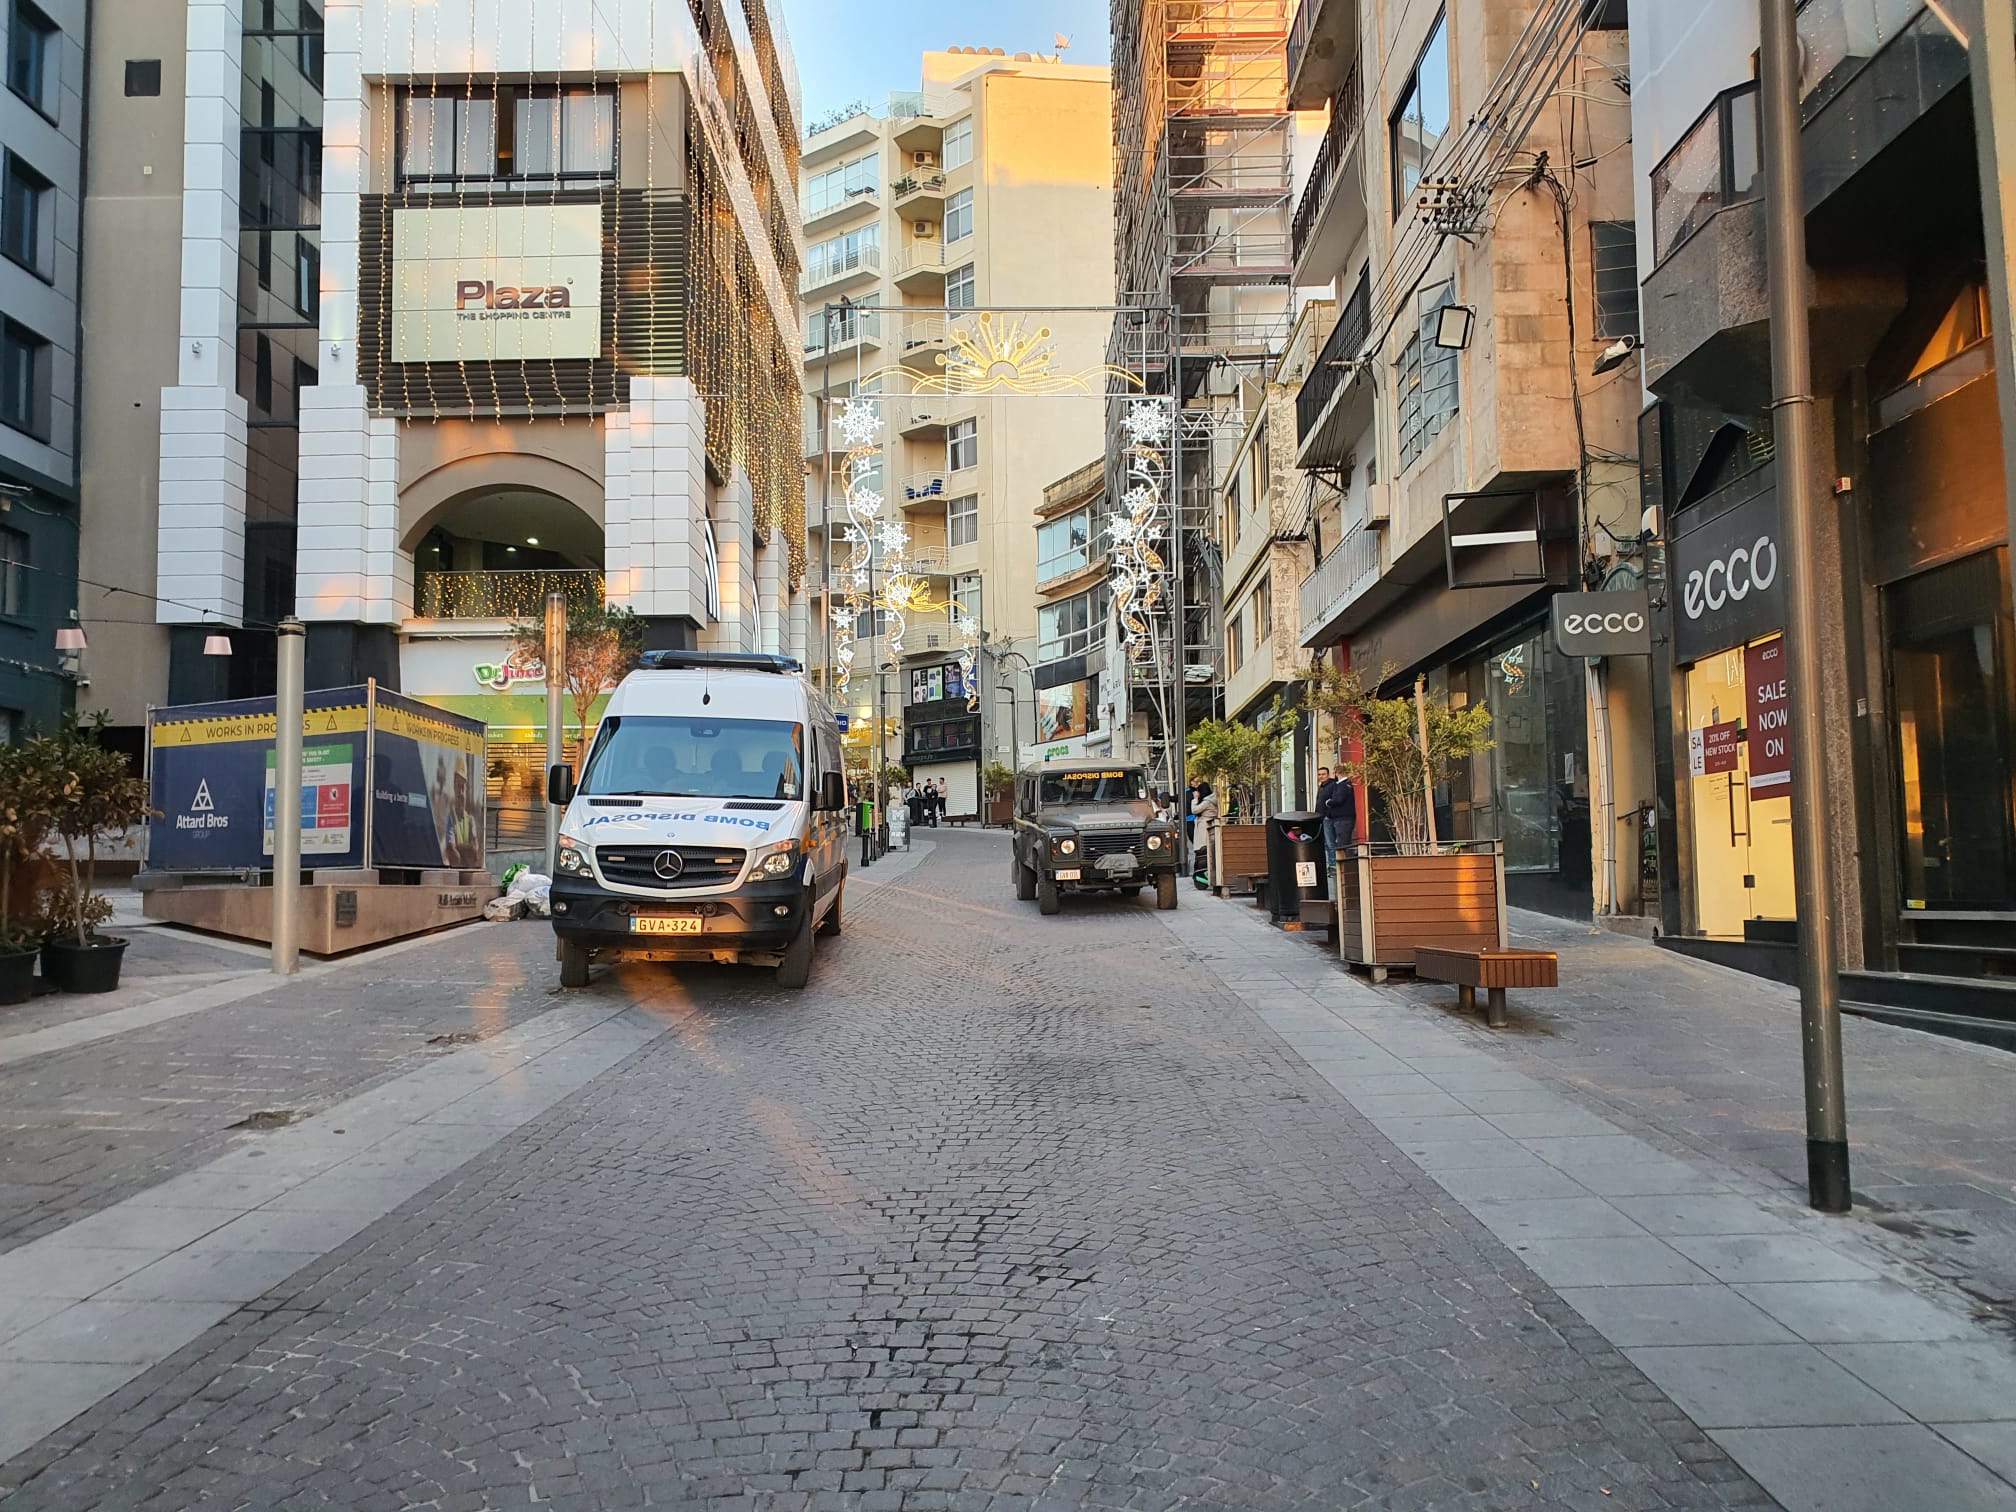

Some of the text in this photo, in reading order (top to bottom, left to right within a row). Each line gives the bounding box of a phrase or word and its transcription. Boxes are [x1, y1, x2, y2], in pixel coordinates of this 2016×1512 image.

[456, 280, 570, 310] Plaza
[456, 311, 571, 321] THE SHOPPING CENTRE
[1684, 536, 1777, 620] ecco
[1564, 612, 1644, 634] ecco
[1762, 648, 1778, 661] ecco
[1758, 680, 1786, 704] SALE
[1758, 707, 1788, 732] NOW
[206, 725, 242, 739] WORKS
[244, 723, 254, 735] IN
[1720, 730, 1731, 741] OFF
[1047, 744, 1069, 757] crocs
[1692, 736, 1702, 750] SA
[1705, 743, 1736, 757] NEW STOCK
[1765, 738, 1784, 758] ON
[1693, 756, 1702, 770] LE
[176, 812, 229, 829] Attard Bros
